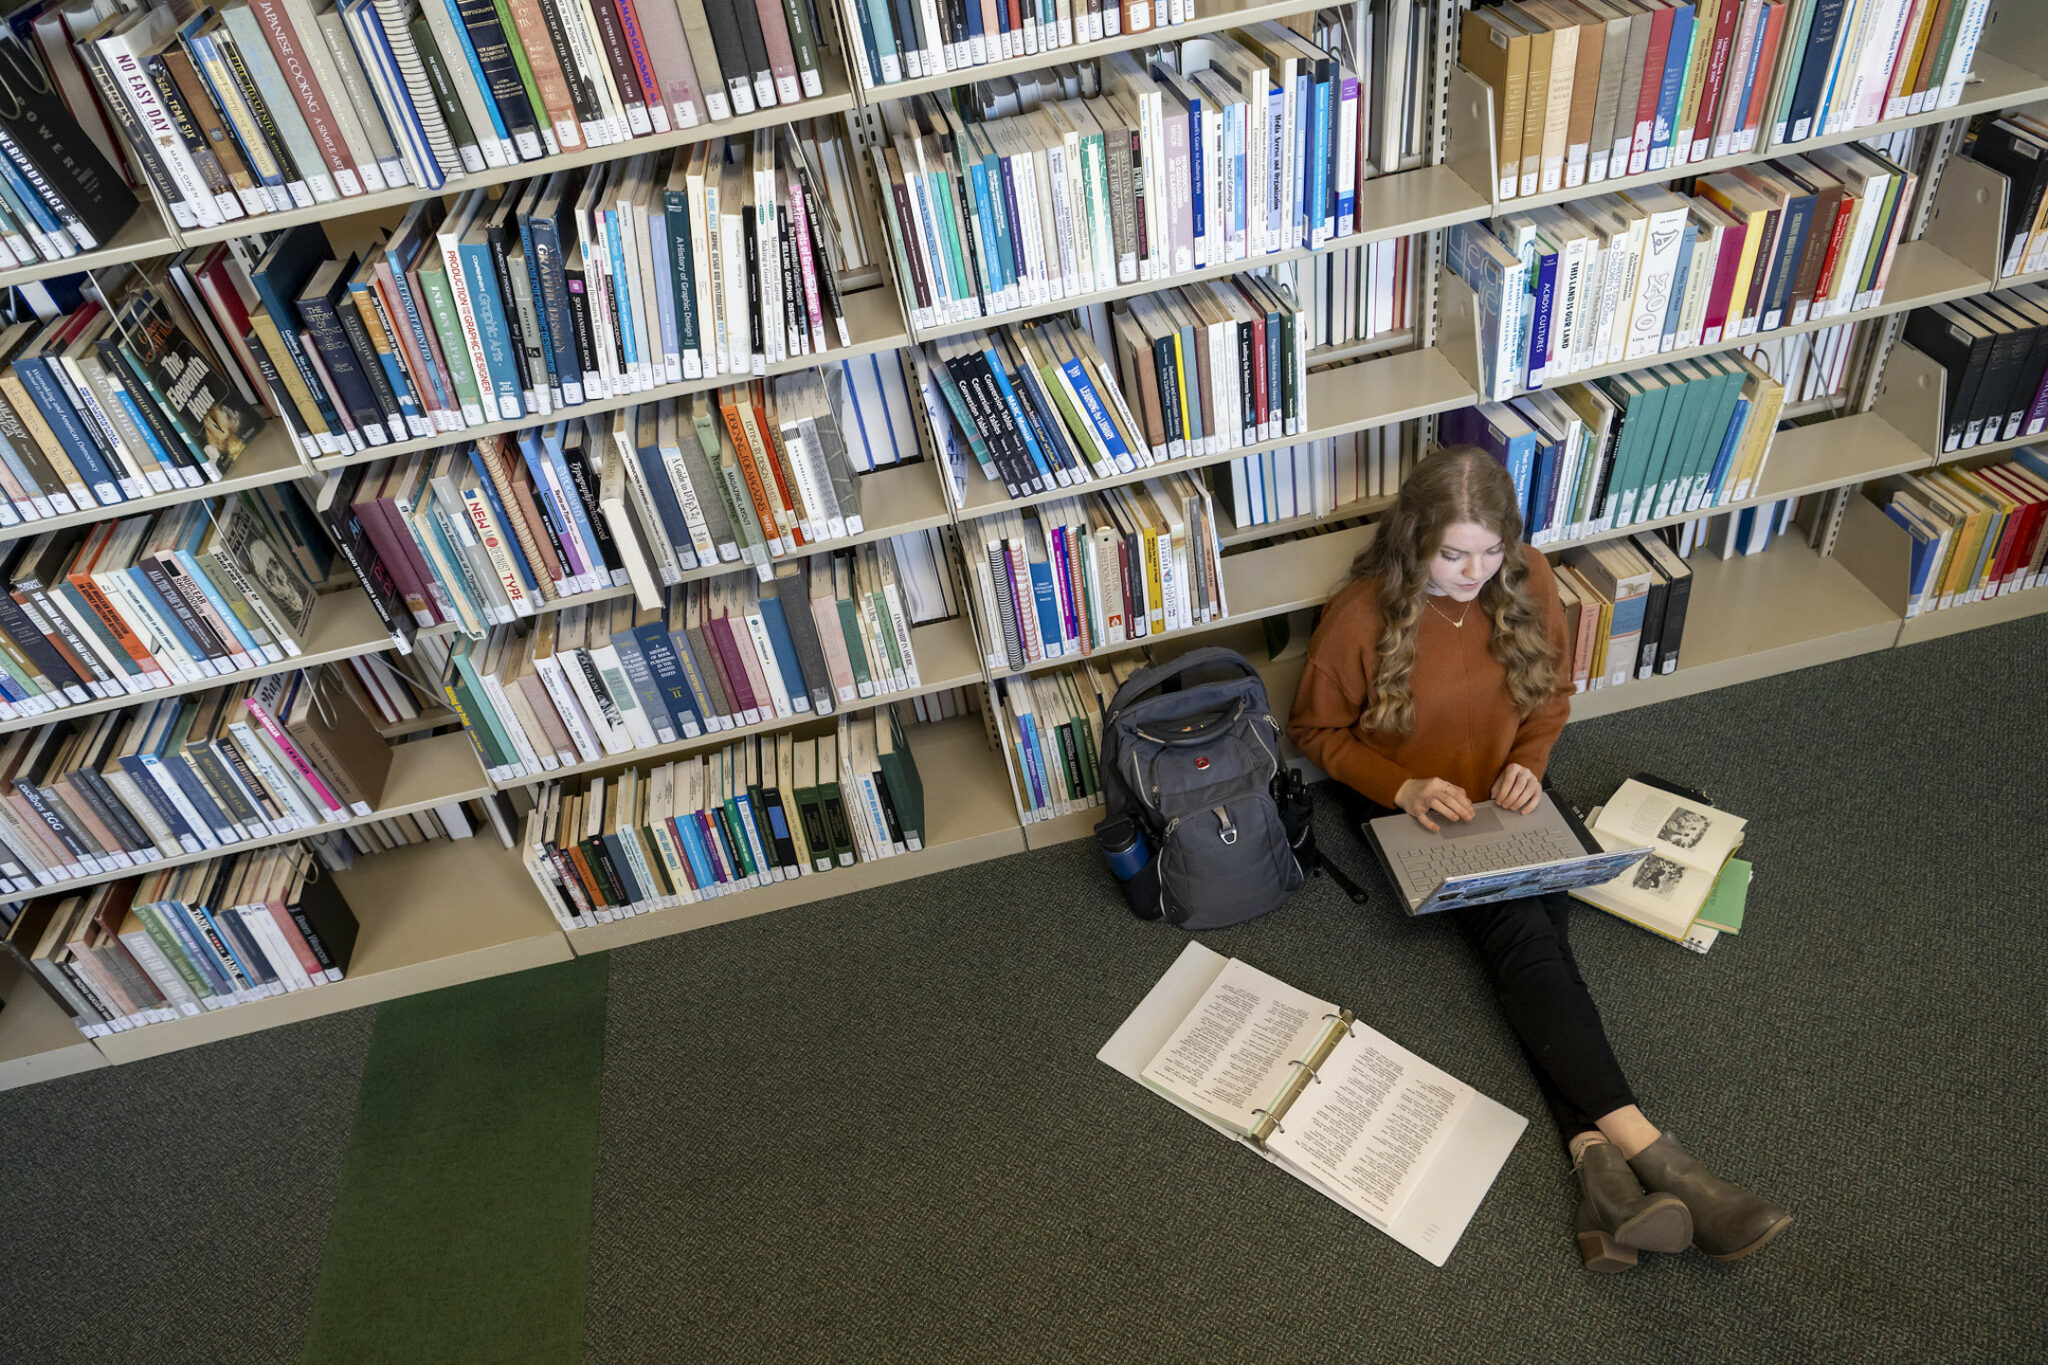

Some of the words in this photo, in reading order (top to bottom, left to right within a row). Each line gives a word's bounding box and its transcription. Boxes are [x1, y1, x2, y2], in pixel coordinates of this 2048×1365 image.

[259, 0, 293, 57] JAPANESE
[552, 31, 561, 41] OF
[562, 14, 570, 26] THE
[566, 27, 576, 43] BOOK
[571, 45, 585, 68] FORMAT
[1969, 25, 1980, 43] the
[556, 42, 566, 57] THE
[630, 37, 654, 90] GLOSSARY
[1960, 46, 1973, 74] Child
[285, 55, 319, 114] COOKING
[561, 57, 575, 83] VISUAL
[115, 52, 136, 75] NO
[127, 72, 155, 108] EASY
[145, 106, 170, 135] DAY
[155, 75, 173, 98] SEAL
[167, 98, 186, 123] TEAM
[180, 122, 196, 141] SIX
[570, 83, 582, 104] BOOK
[314, 116, 322, 124] A
[317, 124, 336, 154] SIMPLE
[168, 148, 185, 173] MARK
[182, 173, 199, 199] OWEN
[331, 154, 344, 171] ART
[1108, 152, 1118, 171] FOR
[1120, 150, 1131, 197] SELECTING
[1110, 173, 1122, 216] LIBRARIES
[1272, 172, 1281, 209] Organization
[1061, 206, 1076, 249] PRESERVING
[1123, 202, 1134, 250] MATERIALS
[673, 243, 686, 270] History
[768, 236, 778, 256] Making
[781, 241, 791, 270] SELLING
[1611, 240, 1619, 248] TO
[679, 271, 687, 280] of
[772, 266, 780, 281] Good
[1569, 260, 1579, 281] THIS
[1605, 250, 1617, 290] CHILDREN'S
[394, 273, 416, 313] GETTING
[678, 281, 691, 311] Graphic
[772, 282, 781, 302] Layout
[783, 272, 793, 300] GRAPHIC
[1538, 282, 1551, 314] ACROSS
[1566, 281, 1577, 303] LAND
[409, 313, 419, 324] IT
[429, 284, 445, 309] INK
[438, 310, 452, 329] ON
[445, 249, 470, 305] PRODUCTION
[463, 313, 481, 350] GRAPHIC
[472, 350, 492, 391] DESIGNER
[786, 302, 796, 328] DESIGN
[1563, 310, 1573, 327] OUR
[1565, 302, 1574, 310] IS
[1599, 292, 1611, 326] READING
[474, 290, 500, 338] Graphic
[488, 336, 506, 363] Arts
[575, 312, 590, 348] HANDMADE
[682, 312, 694, 337] Design
[1533, 315, 1548, 353] CULTURES
[1560, 329, 1571, 349] LAND
[346, 314, 372, 360] ALTERNATIVE
[368, 361, 387, 393] LITERARY
[412, 323, 433, 361] PRINTED
[540, 329, 557, 372] DESIGNERS
[160, 351, 184, 380] The
[582, 348, 593, 370] BOOKS
[1508, 349, 1516, 372] Child
[166, 356, 210, 412] Eleventh
[1077, 384, 1101, 414] LEARNING
[186, 385, 215, 423] Hour
[958, 379, 980, 417] Conversion
[974, 415, 990, 438] Tables
[970, 376, 993, 415] Conversion
[987, 413, 1004, 435] Tables
[982, 372, 1006, 411] Conversion
[1000, 409, 1016, 432] Tables
[1092, 410, 1104, 421] the
[30, 367, 57, 402] Warmaking
[52, 401, 64, 415] and
[59, 413, 80, 441] American
[75, 440, 100, 474] Democracy
[1005, 393, 1023, 417] MARC
[1014, 416, 1034, 443] Manual
[1096, 418, 1116, 442] LIBRARY
[744, 420, 760, 447] EDITING
[740, 454, 752, 471] FOR
[753, 446, 763, 455] BY
[1521, 447, 1529, 463] What
[756, 454, 771, 479] DESIGN
[1520, 464, 1526, 473] Do
[745, 470, 766, 512] MAGAZINES
[1516, 474, 1525, 492] Young
[553, 488, 564, 504] Texts
[560, 510, 572, 525] Type
[568, 460, 595, 503] Typography
[585, 500, 609, 541] Referenced
[724, 471, 744, 504] MAGAZINE
[736, 502, 752, 526] LAYOUT
[465, 499, 493, 532] NEW
[761, 513, 773, 532] WHITE
[147, 566, 162, 582] ALL
[155, 577, 170, 593] THE
[213, 552, 228, 570] PEACE
[226, 569, 237, 581] AND
[234, 580, 247, 594] WAR
[218, 550, 229, 562] THE
[226, 561, 252, 593] GEOGRAPHY
[250, 592, 259, 601] OF
[1099, 547, 1109, 582] FREEDOM
[172, 577, 206, 615] SHOWDOWN
[179, 573, 207, 606] NUCLEAR
[340, 542, 358, 567] AMERICAN
[354, 565, 365, 579] TYPE
[361, 578, 374, 594] DESIGN
[373, 597, 390, 622] DESIGNERS
[500, 572, 525, 603] TYPE
[1103, 584, 1112, 613] MANUAL
[575, 654, 602, 693] KATHARINE
[221, 742, 240, 764] DEADLY
[308, 740, 326, 760] Voices
[321, 758, 336, 774] from
[331, 771, 352, 796] Captivity
[41, 808, 65, 833] EGG
[191, 908, 210, 931] TANK
[222, 954, 241, 976] TANK
